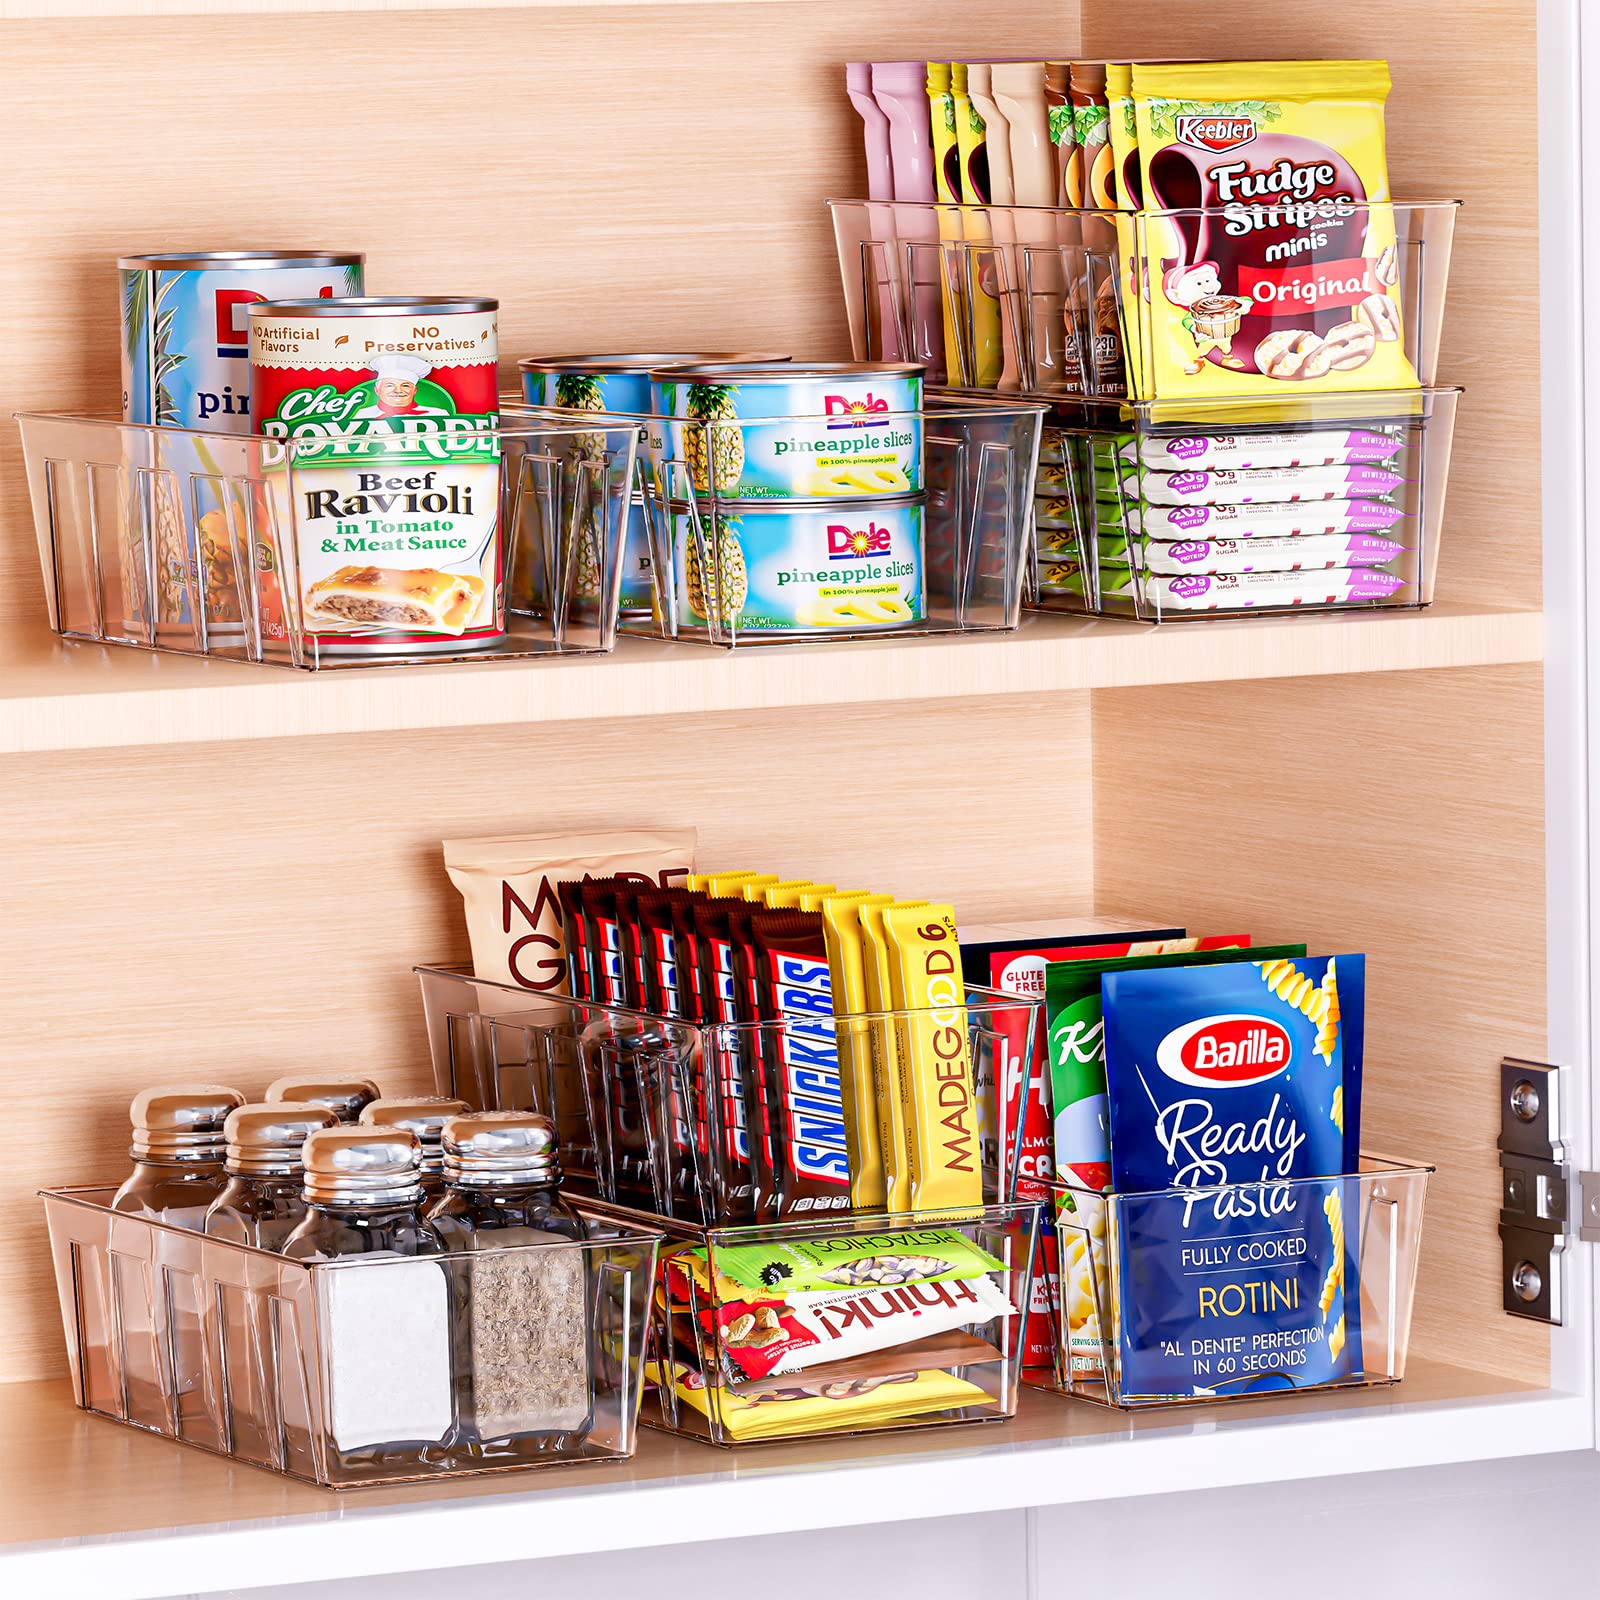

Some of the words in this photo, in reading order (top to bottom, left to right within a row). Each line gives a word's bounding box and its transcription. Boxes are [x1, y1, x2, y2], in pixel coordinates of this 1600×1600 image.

[1180, 118, 1254, 143] Keebler
[1209, 162, 1334, 200] Fudge
[1224, 195, 1355, 235] Stripes
[1310, 219, 1344, 231] cookies
[1265, 231, 1328, 262] minis
[1253, 272, 1372, 304] Original
[263, 327, 320, 340] Artificial
[413, 327, 439, 338] NO
[261, 340, 299, 352] Flavors
[364, 338, 476, 352] Preservatives
[281, 388, 363, 420] Chef
[824, 392, 889, 424] Dole
[774, 434, 880, 455] pineapple
[883, 431, 912, 448] slices
[1169, 438, 1204, 451] 20g
[1179, 448, 1204, 457] PROTEIN
[853, 457, 884, 465] pineapple
[358, 472, 437, 491] Beef
[1170, 472, 1205, 485] 20g
[1180, 483, 1205, 492] PROTEIN
[304, 485, 474, 520] Ravioli
[1170, 507, 1205, 520] 20g
[336, 521, 360, 534] in
[366, 519, 454, 534] Tomato
[1180, 518, 1205, 527] PROTEIN
[321, 538, 339, 552] &
[344, 538, 404, 552] Meat
[407, 535, 467, 550] Sauce
[827, 522, 892, 555] Dole
[1171, 542, 1205, 554] 20g
[1181, 553, 1205, 561] PROTEIN
[777, 564, 882, 586] pineapple
[885, 561, 914, 578] slices
[1172, 577, 1206, 589] 20g
[855, 587, 886, 595] pineapple
[1181, 587, 1206, 596] PROTEIN
[917, 923, 947, 941] 6
[1006, 970, 1044, 981] GLUTE
[1016, 982, 1045, 992] FREE
[1194, 1029, 1284, 1069] Barilla
[783, 959, 849, 1175] SNICKERS
[925, 949, 974, 1173] MADEGOOD
[1157, 1093, 1306, 1176] Ready
[1174, 1160, 1297, 1228] Pasta
[811, 1232, 959, 1252] PISTACHIOS
[1181, 1245, 1232, 1267] FULLY
[1237, 1237, 1307, 1261] COOKED
[824, 1293, 857, 1305] PROTEIN
[859, 1288, 877, 1297] HIGH
[1199, 1277, 1299, 1319] ROTINI
[808, 1301, 823, 1309] BAR
[813, 1279, 978, 1340] think!
[790, 1338, 817, 1351] Peanut
[1160, 1341, 1185, 1357] "AL
[1191, 1336, 1246, 1356] DENTE"
[1252, 1325, 1324, 1351] PERFECTION
[767, 1346, 790, 1360] Butter
[1031, 1344, 1043, 1354] NET
[1072, 1358, 1083, 1370] NET
[1193, 1359, 1210, 1375] IN
[1217, 1357, 1236, 1374] 60
[1242, 1349, 1307, 1371] SECONDS
